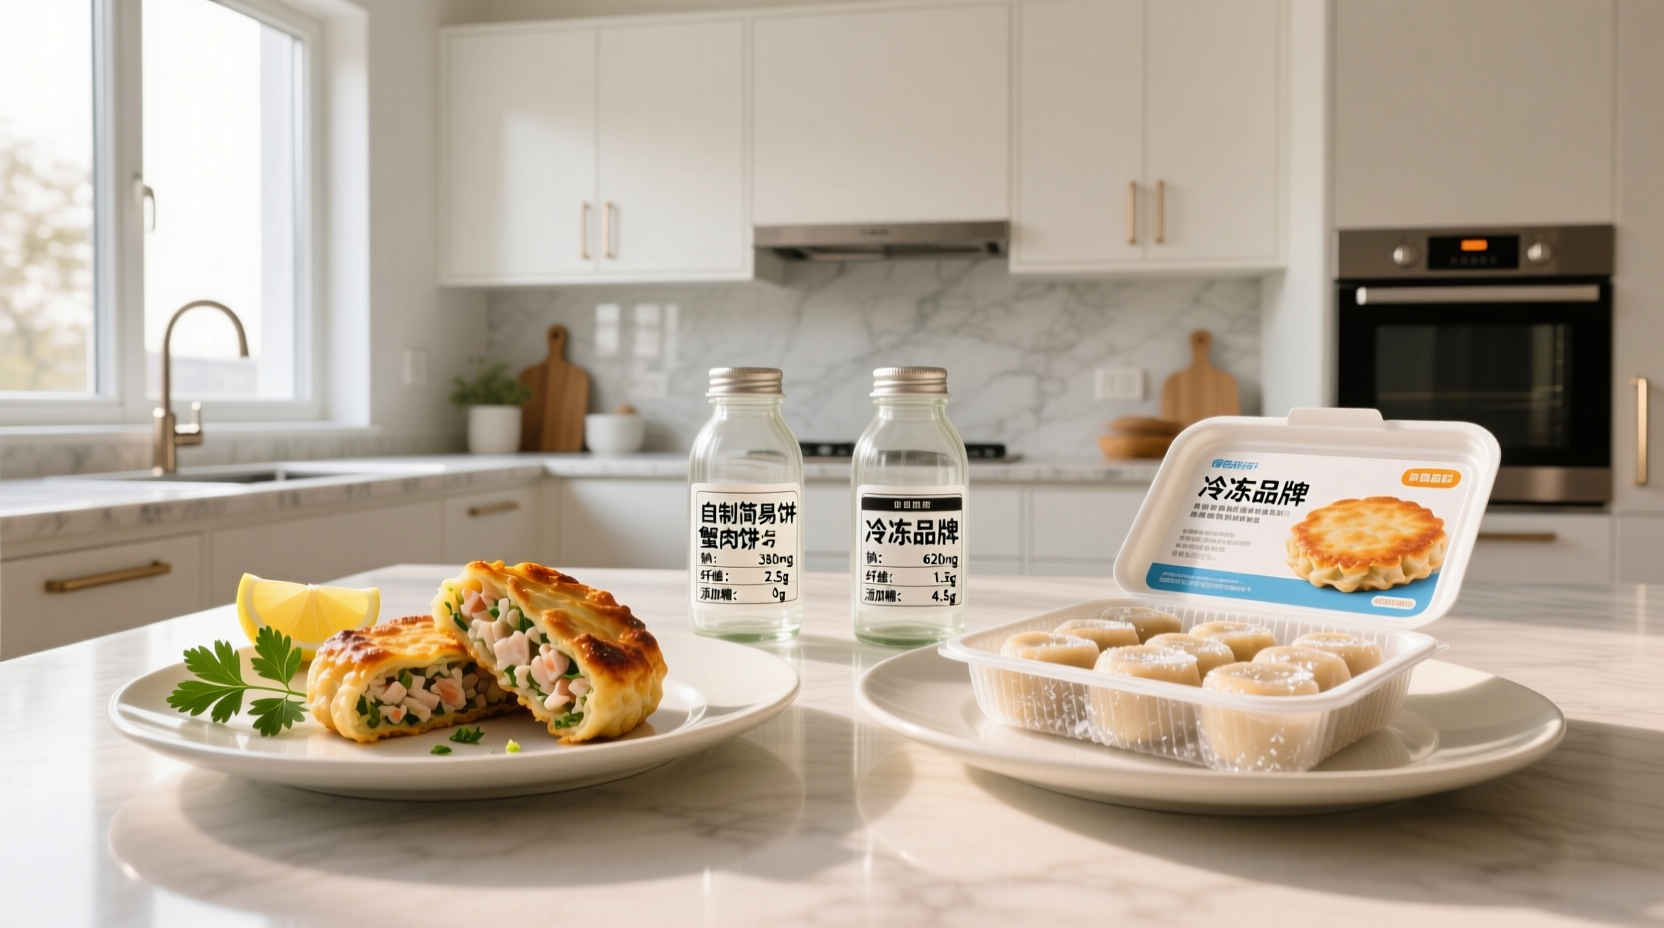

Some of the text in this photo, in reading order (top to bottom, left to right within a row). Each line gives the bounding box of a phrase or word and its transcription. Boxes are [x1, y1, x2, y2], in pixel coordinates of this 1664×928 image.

[1198, 475, 1310, 507] 冷冻品牌
[701, 501, 797, 525] 自制简易饼
[865, 518, 959, 546] 冷冻品牌
[764, 571, 789, 585] 2.5g
[772, 587, 785, 602] 0g
[931, 589, 956, 605] 4.5g
